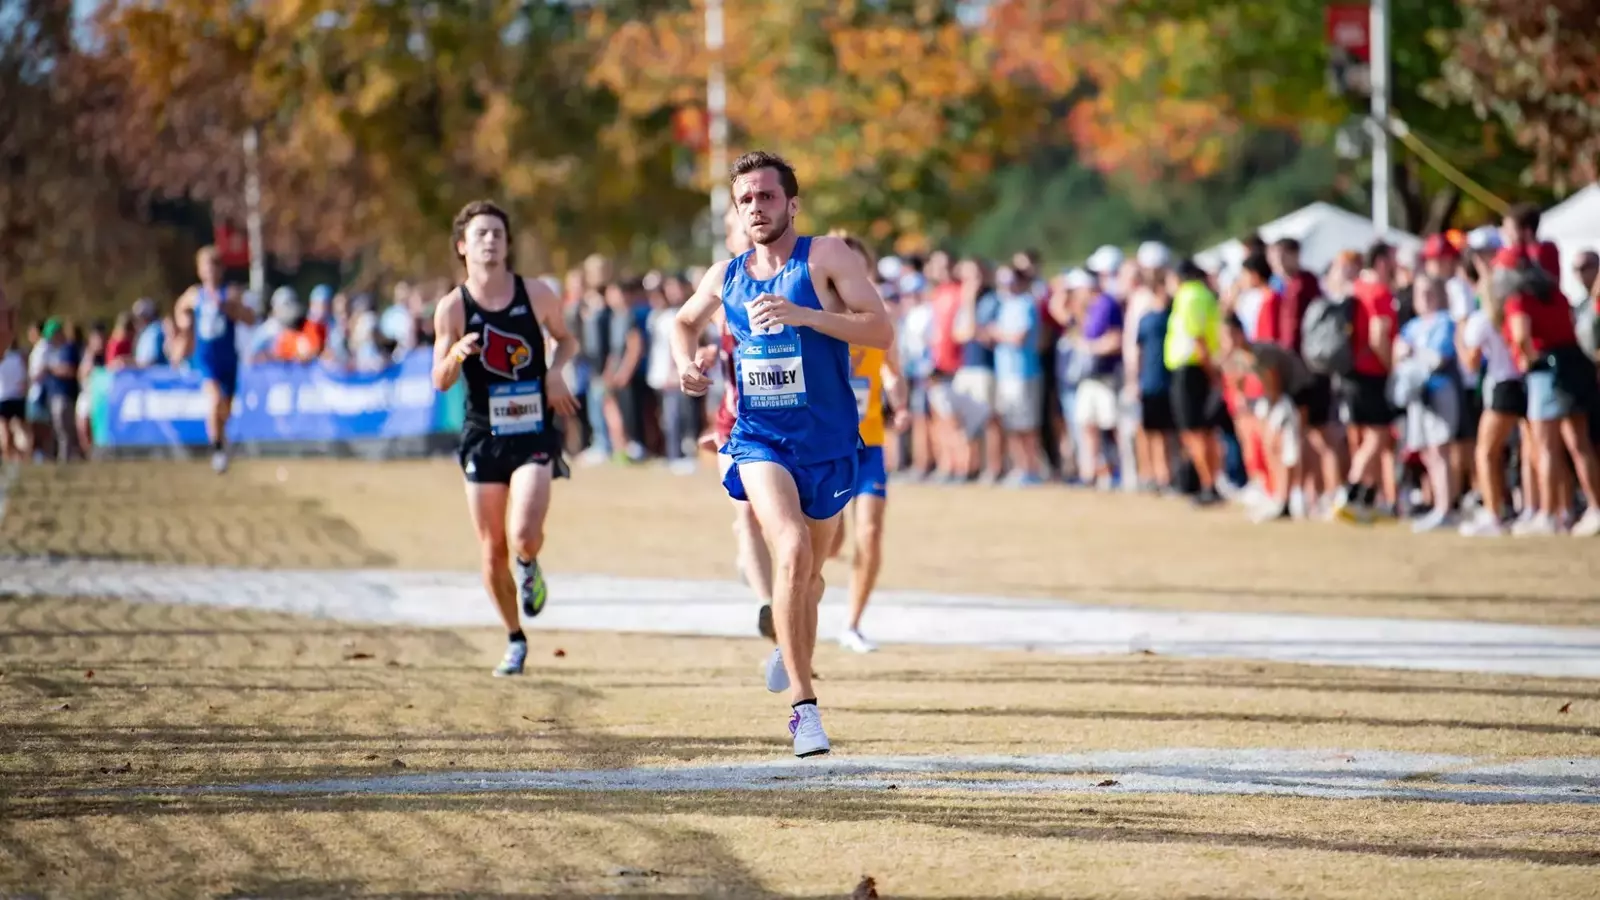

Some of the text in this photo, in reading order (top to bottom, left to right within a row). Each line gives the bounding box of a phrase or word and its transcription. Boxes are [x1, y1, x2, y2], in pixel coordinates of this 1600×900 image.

[744, 346, 762, 354] ACC
[748, 370, 796, 386] STANLEY
[751, 398, 798, 407] CHAMPIONSHIPS
